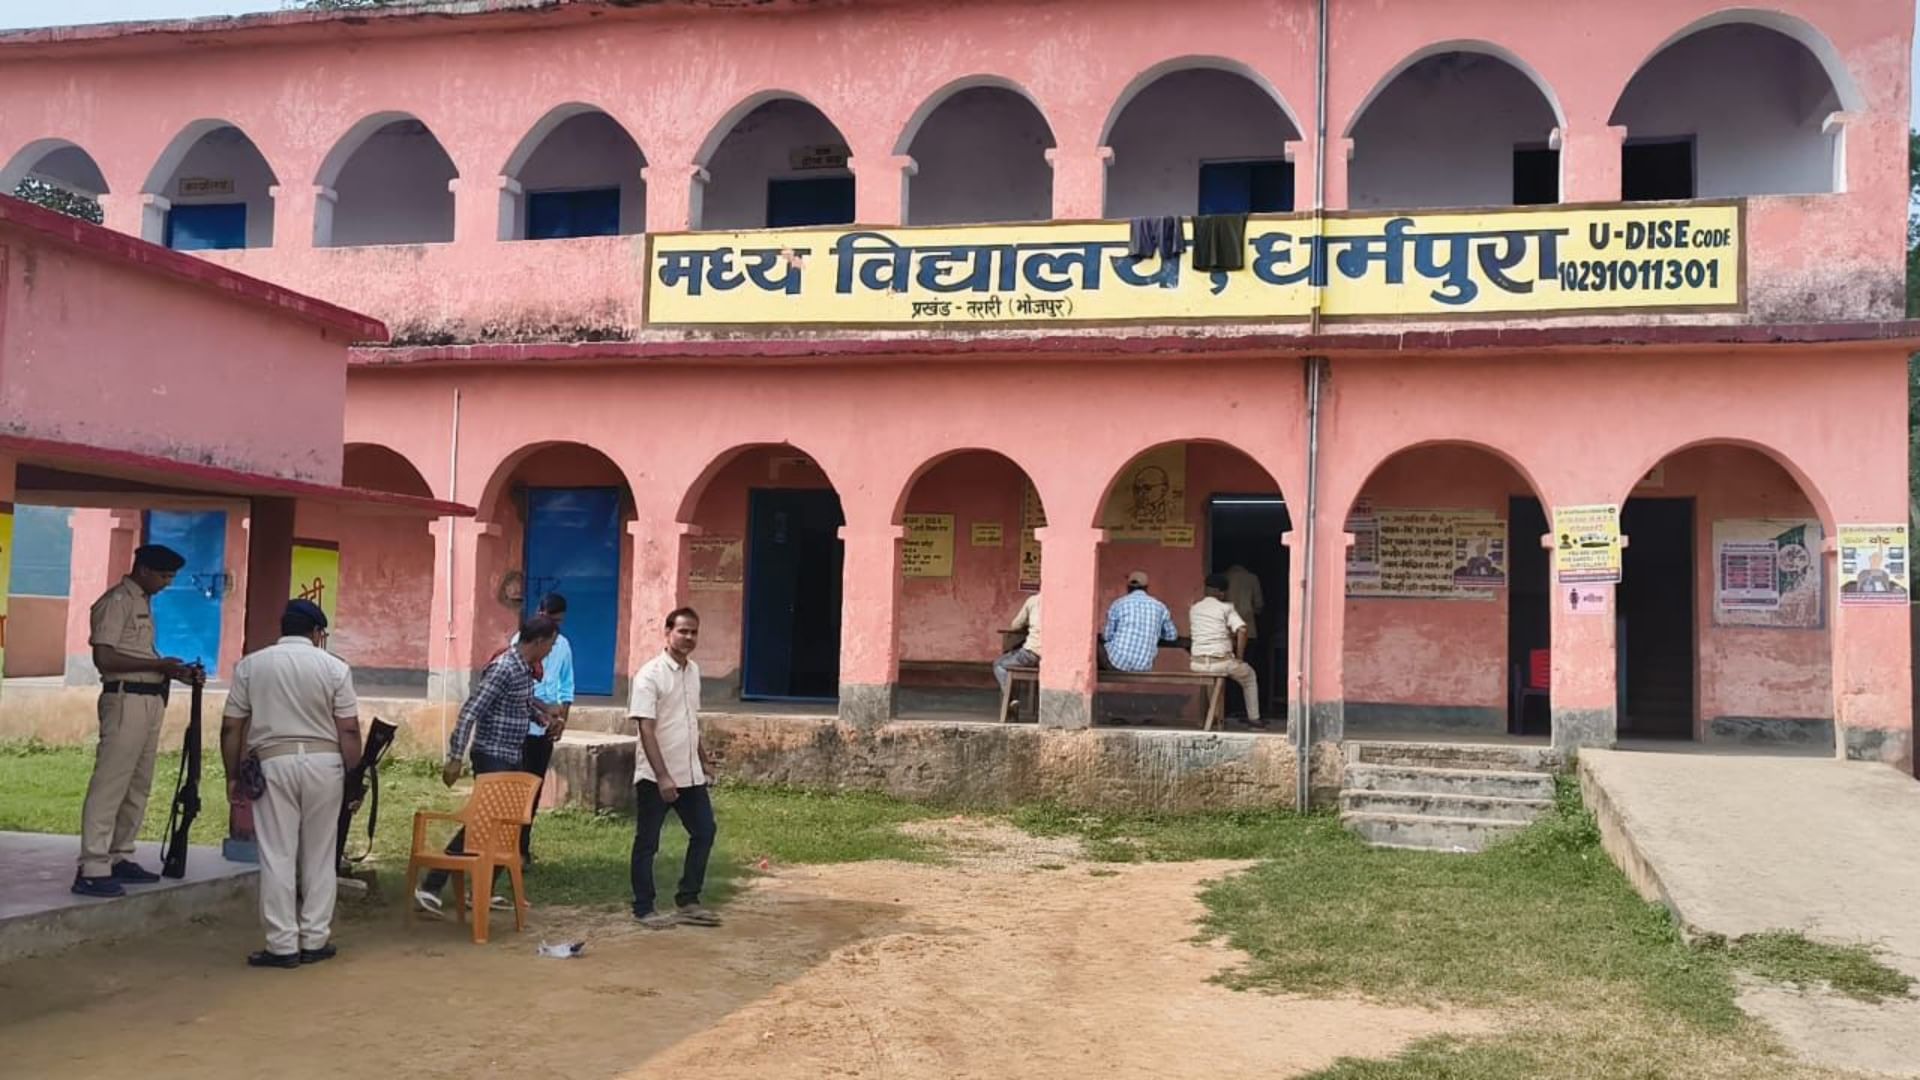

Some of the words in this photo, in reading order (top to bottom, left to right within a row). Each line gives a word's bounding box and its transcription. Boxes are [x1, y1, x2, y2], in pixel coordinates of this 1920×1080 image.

[1588, 219, 1691, 250] U-DISE
[1692, 228, 1731, 249] CODE
[656, 246, 812, 296] मध्य
[1248, 217, 1569, 306] धर्मपुरा
[1558, 258, 1719, 292] 10291011301
[911, 297, 952, 319] प्रखंड
[966, 294, 1003, 319] तरारी
[1009, 293, 1074, 318] (भोजपुर)
